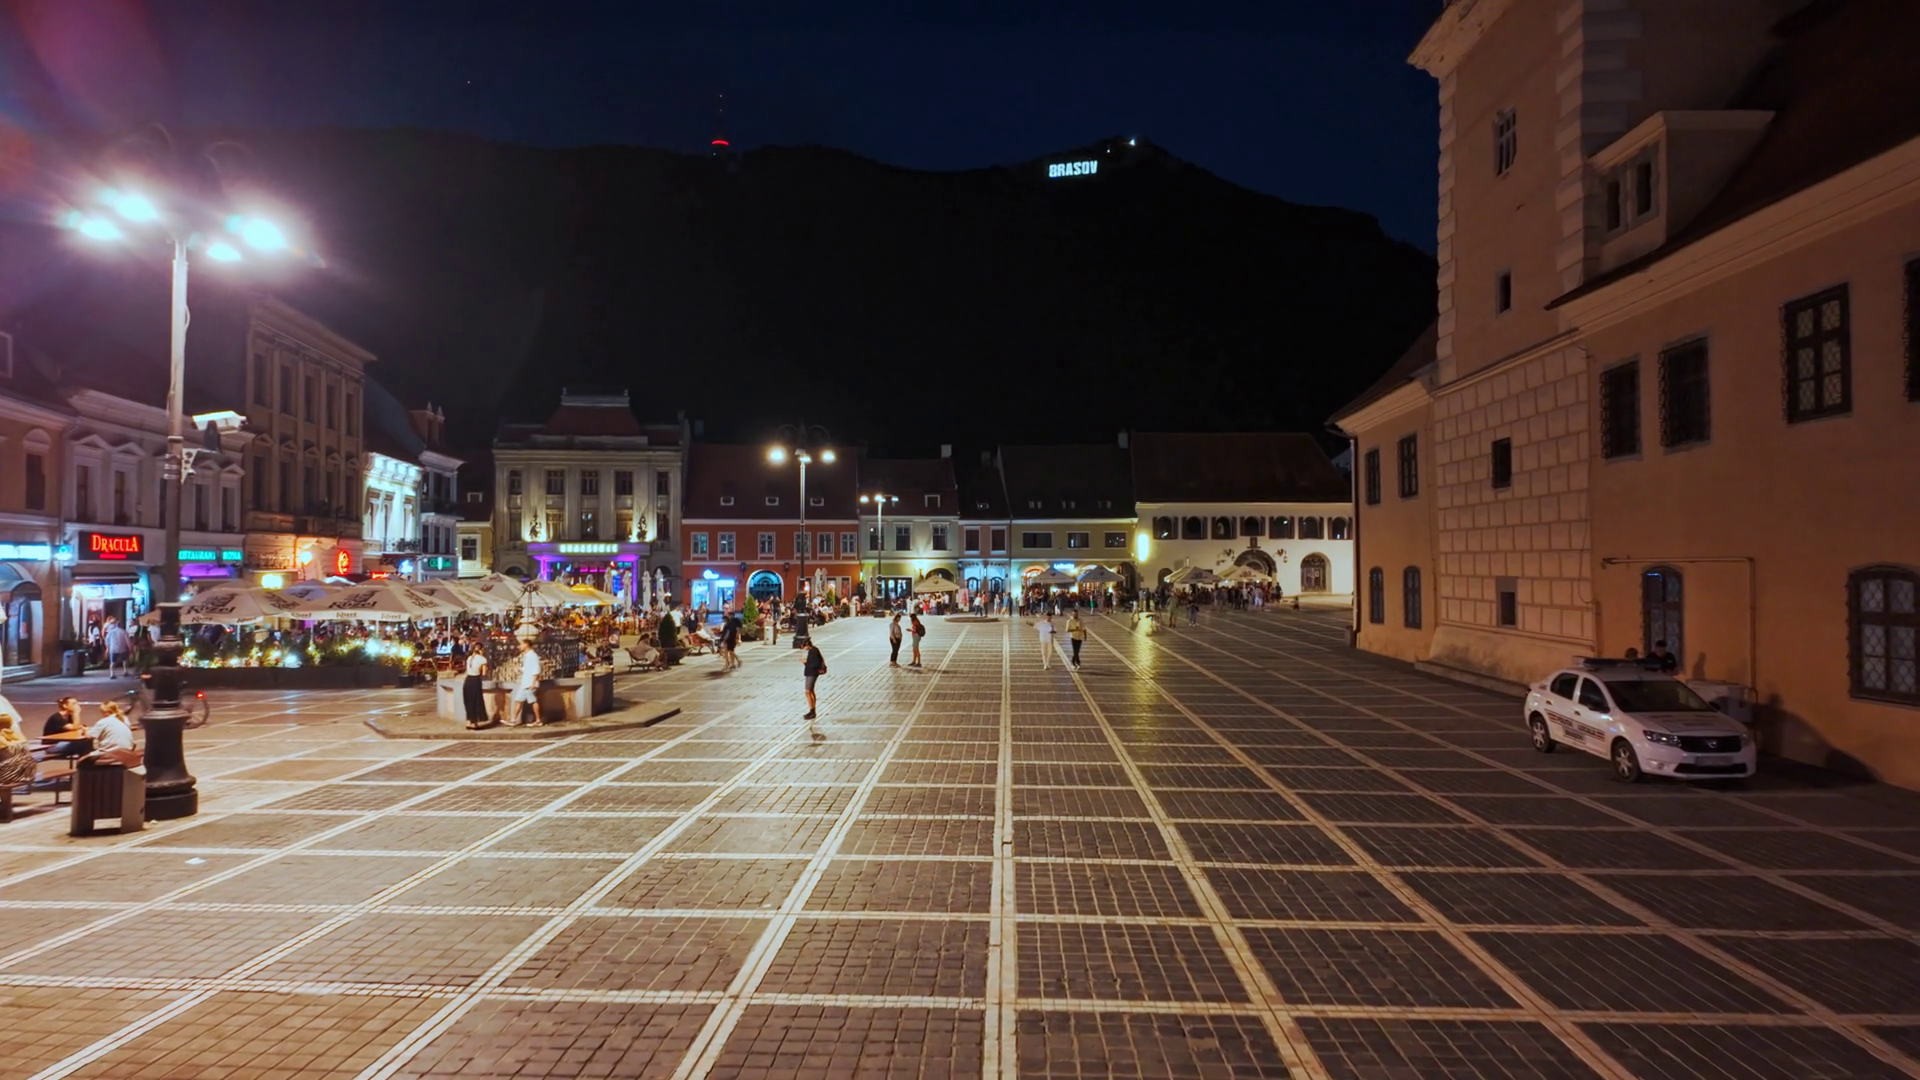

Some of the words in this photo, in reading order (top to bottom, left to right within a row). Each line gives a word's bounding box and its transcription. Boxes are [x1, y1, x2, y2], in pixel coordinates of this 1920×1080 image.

[1049, 160, 1098, 178] BRASOV
[91, 534, 139, 553] DRACULA
[178, 550, 217, 560] ESTAURANT
